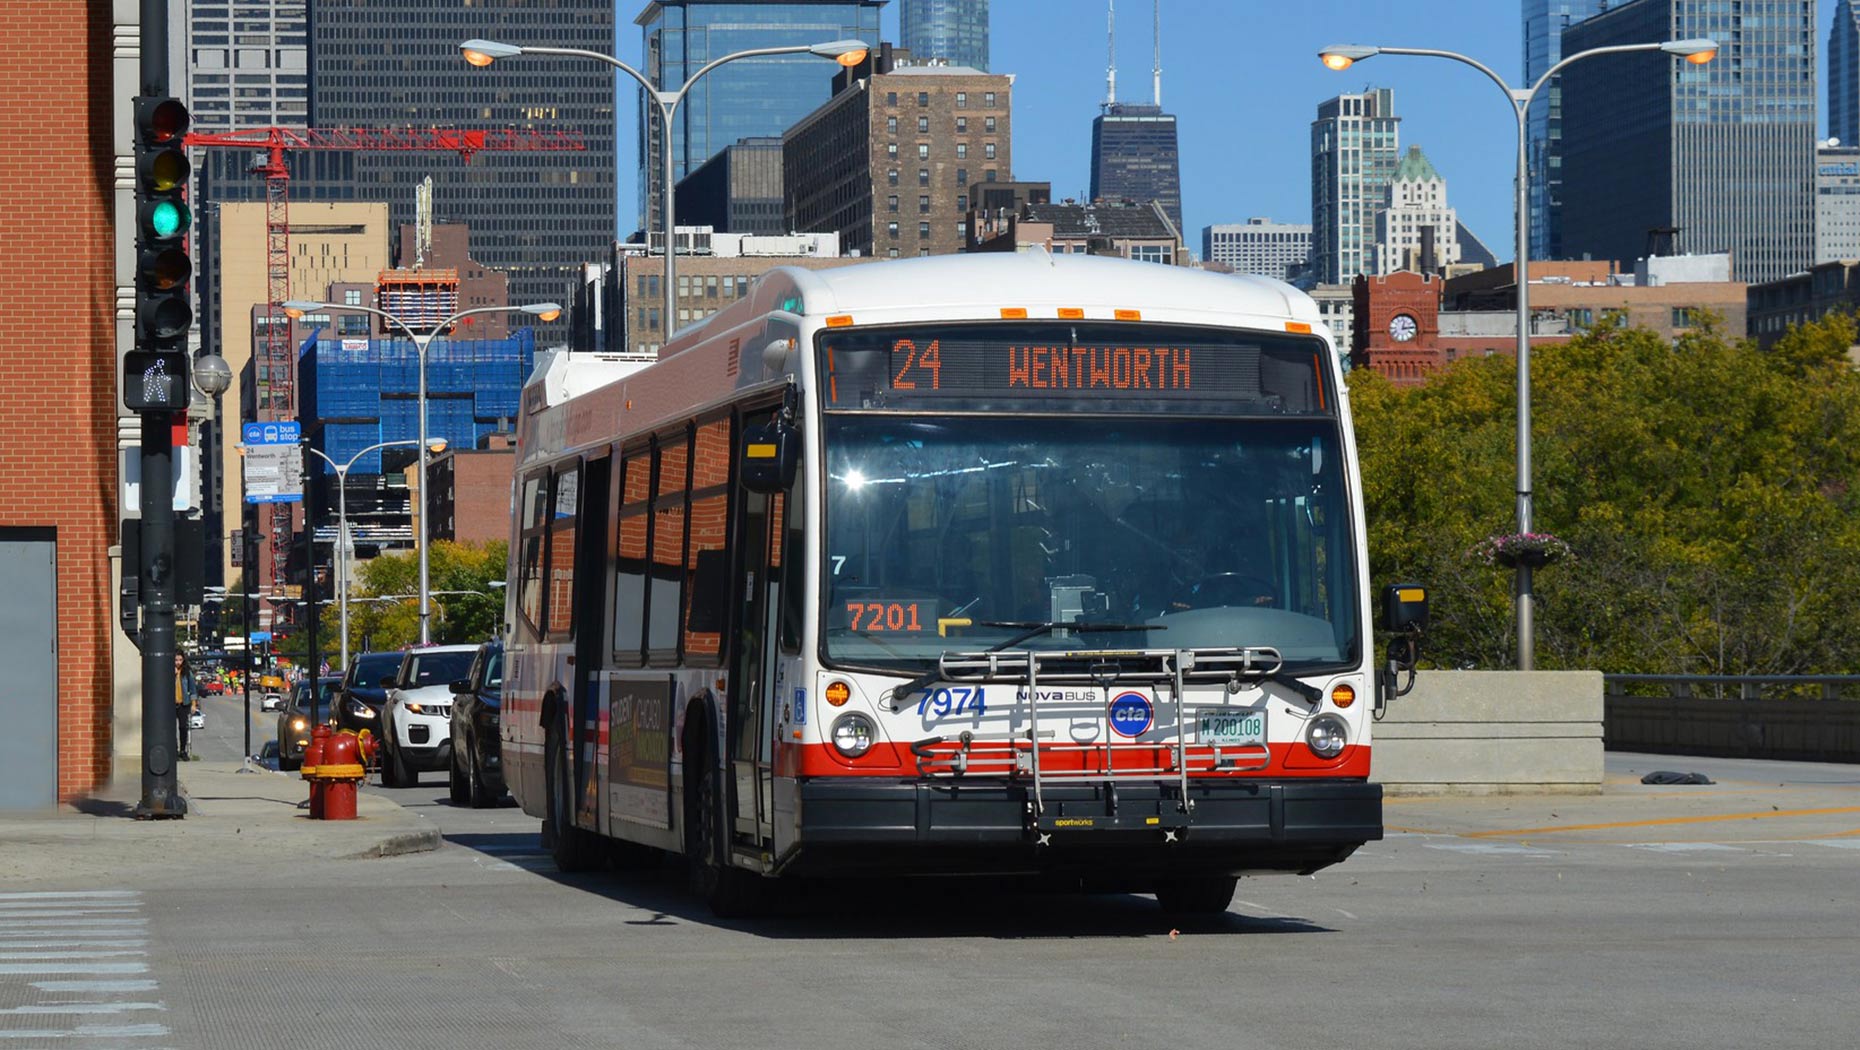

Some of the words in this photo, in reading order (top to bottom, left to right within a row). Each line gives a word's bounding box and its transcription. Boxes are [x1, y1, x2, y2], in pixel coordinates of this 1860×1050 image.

[893, 339, 941, 390] 24
[1009, 346, 1190, 389] WENTWORTH
[280, 424, 295, 433] bus
[280, 432, 299, 442] stop
[831, 555, 846, 575] 7
[847, 603, 921, 631] 7201
[913, 688, 988, 716] 7974
[1115, 706, 1146, 722] cta
[1213, 718, 1261, 736] 200108
